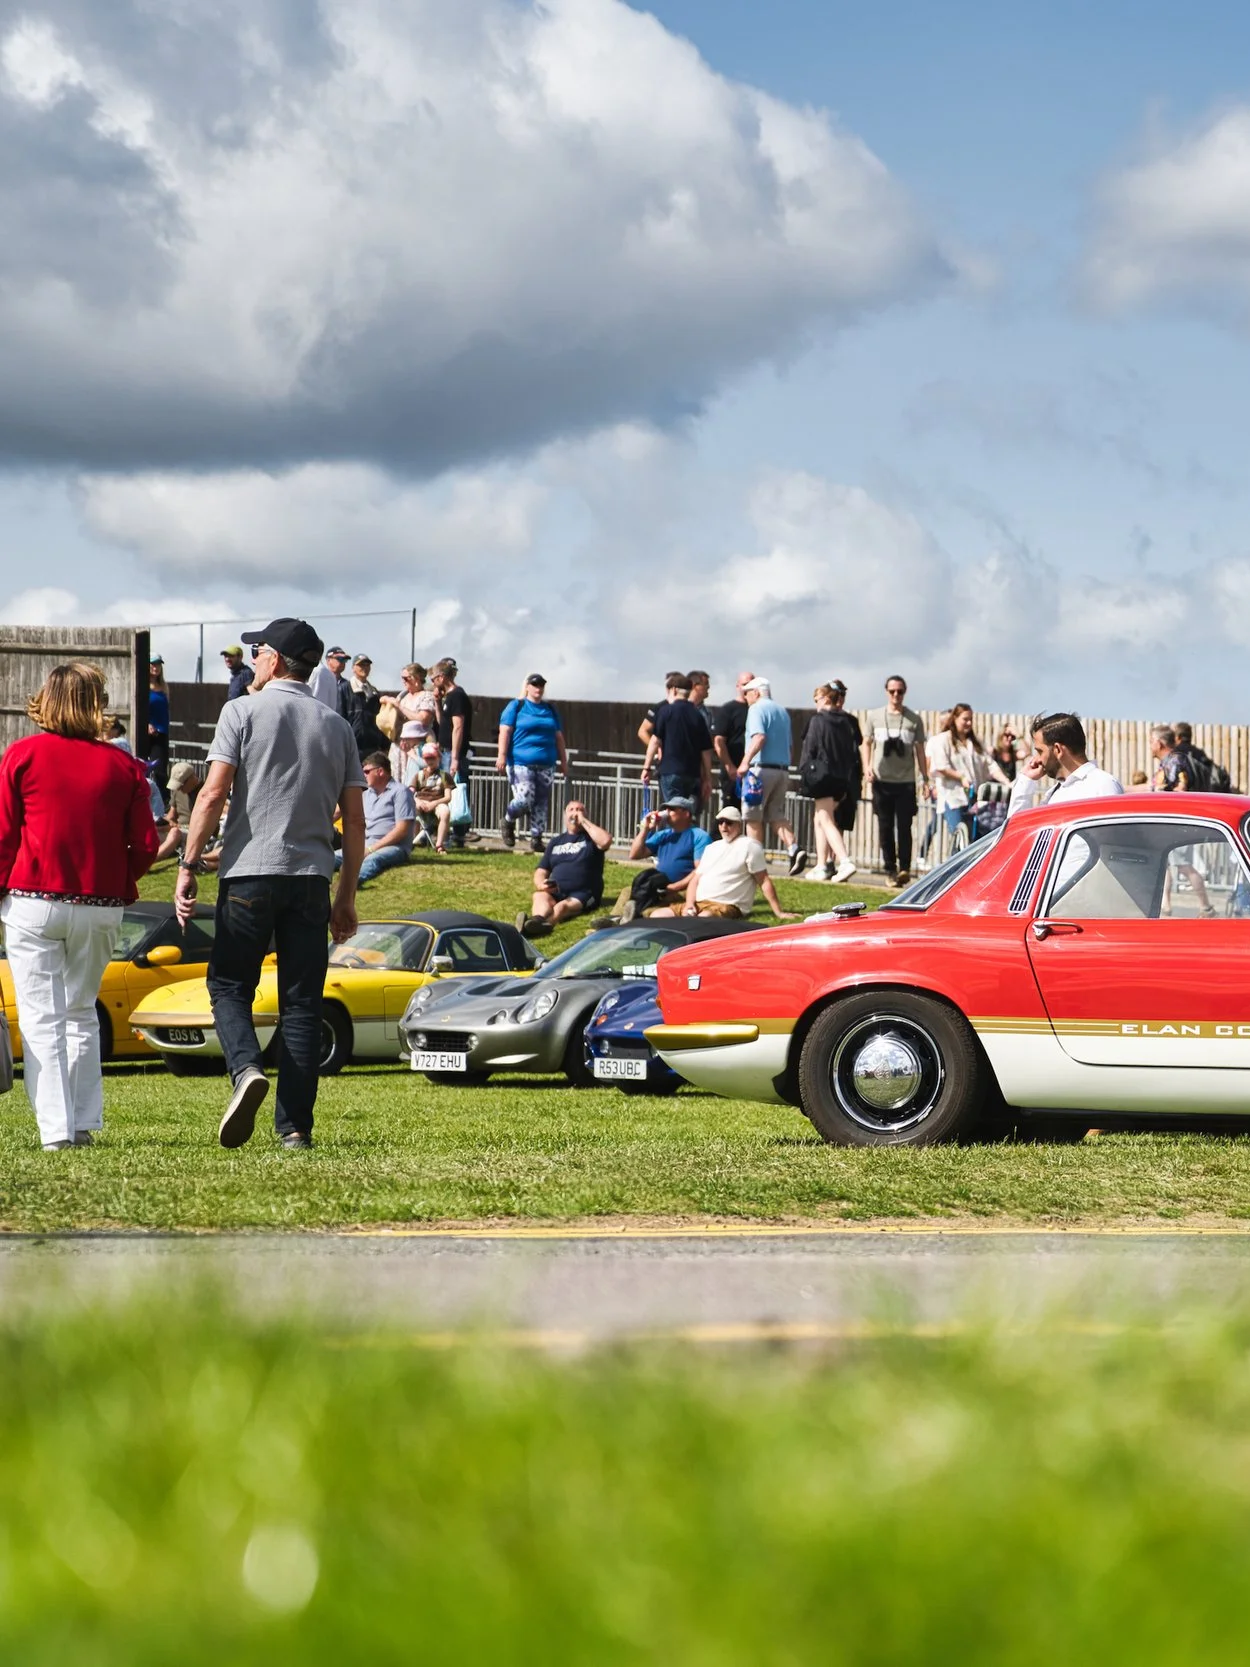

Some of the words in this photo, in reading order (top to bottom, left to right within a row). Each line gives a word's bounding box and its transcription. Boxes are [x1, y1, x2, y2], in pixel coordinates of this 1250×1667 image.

[1121, 1023, 1200, 1035] ELAN
[414, 1054, 438, 1068] V727
[440, 1054, 461, 1068] EHU
